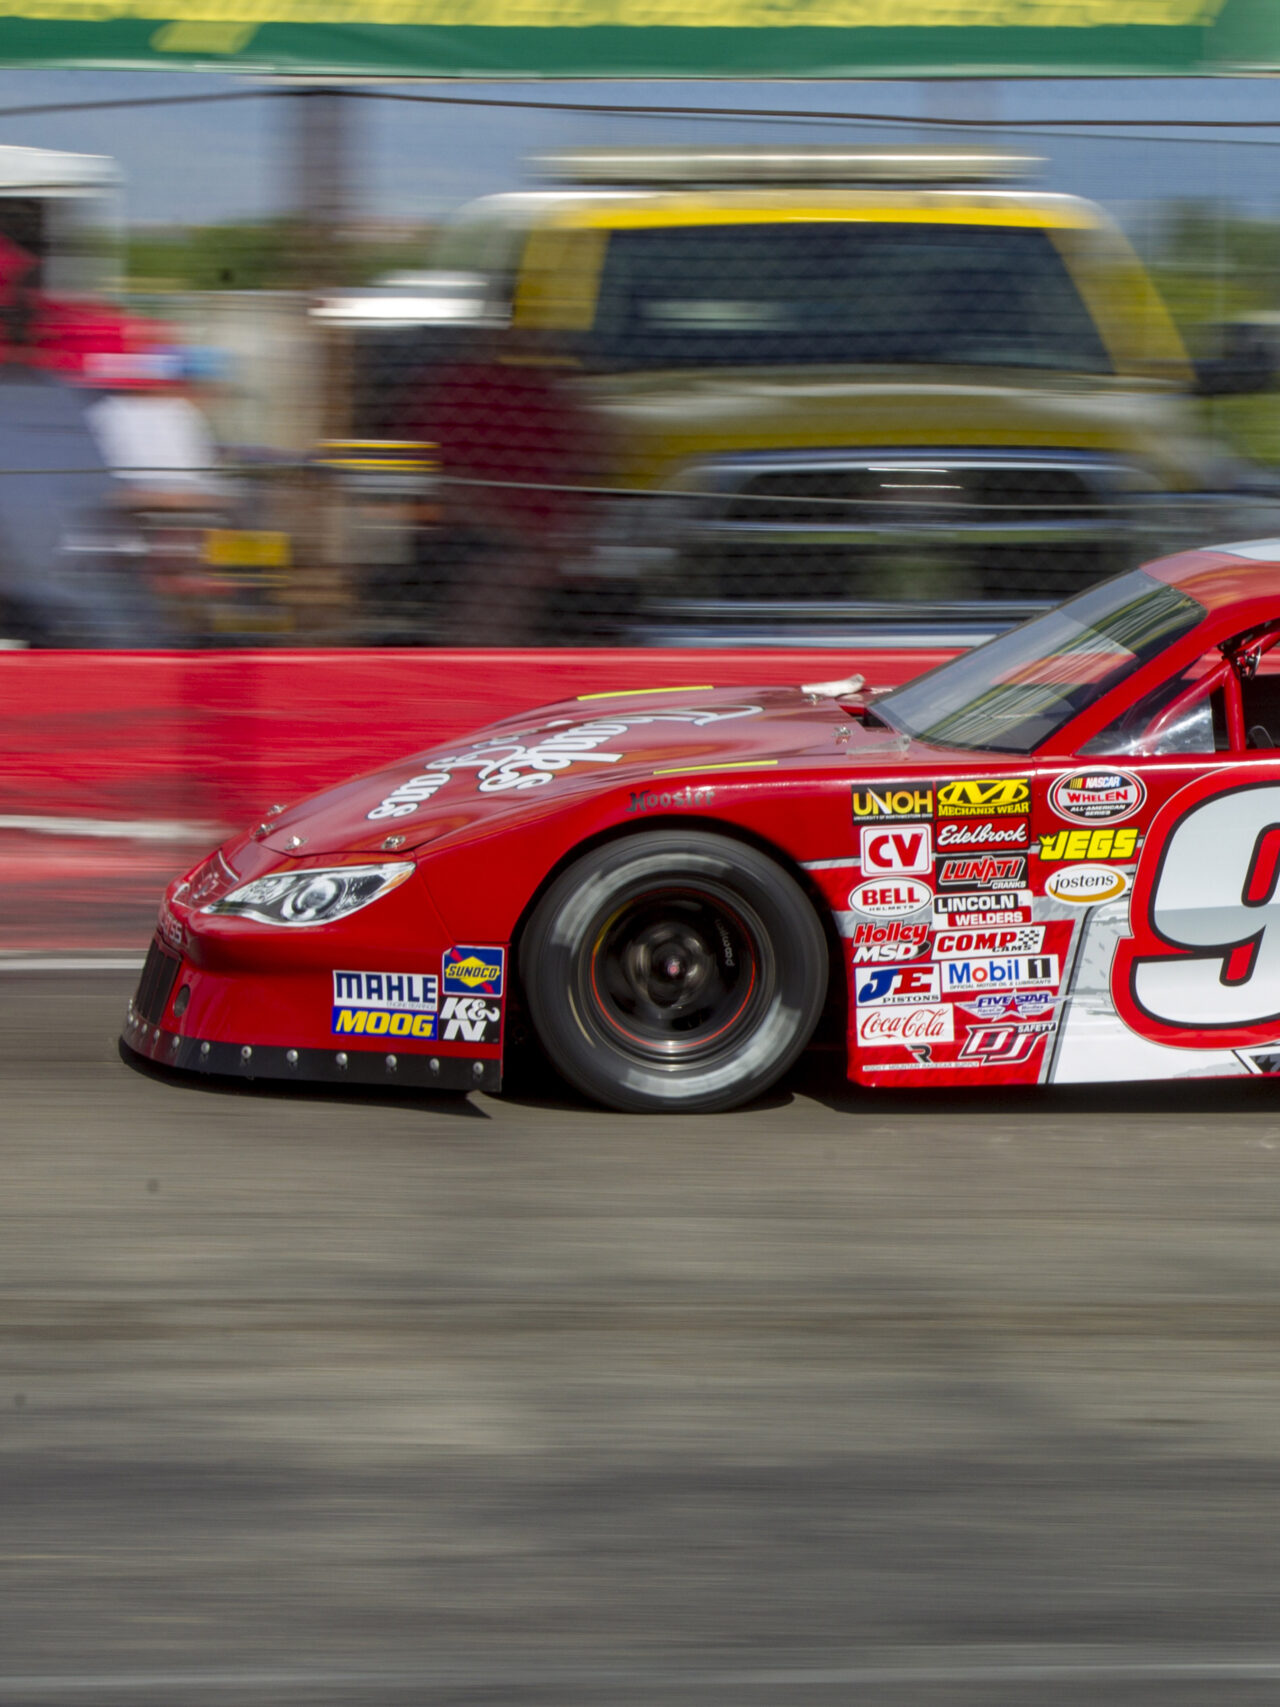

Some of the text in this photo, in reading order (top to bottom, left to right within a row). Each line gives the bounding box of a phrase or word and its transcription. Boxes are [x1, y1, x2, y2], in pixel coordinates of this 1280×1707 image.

[1085, 776, 1121, 788] NASCAR
[627, 786, 716, 813] Hoosier
[853, 788, 933, 816] UNOH
[1067, 788, 1129, 804] WHELEN
[938, 801, 1029, 816] MECHANIX WEAR
[1071, 804, 1125, 813] ALL-AMERICAN
[938, 823, 1027, 846] Edelbrock
[868, 833, 923, 868] CV
[1040, 829, 1138, 861] JEGS
[942, 857, 1021, 884] LUNATI
[992, 881, 1026, 889] CRANKS
[1053, 872, 1115, 895] jostens
[862, 887, 920, 906] BELL
[937, 895, 1015, 913] LINCOLN
[955, 911, 1023, 926] WELDERS
[854, 921, 929, 946] Holley
[937, 931, 1017, 953] COMP
[852, 943, 919, 963] MSD
[992, 944, 1032, 953] CAMS
[448, 966, 498, 979] SUNOCO
[949, 959, 1019, 984] Mobil
[336, 972, 436, 1003] MAHLE
[858, 966, 934, 1003] JE
[882, 995, 939, 1004] PISTONS
[977, 994, 1050, 1008] FIVE STAR
[335, 1010, 435, 1038] MOOG
[1018, 1022, 1054, 1033] SAFETY
